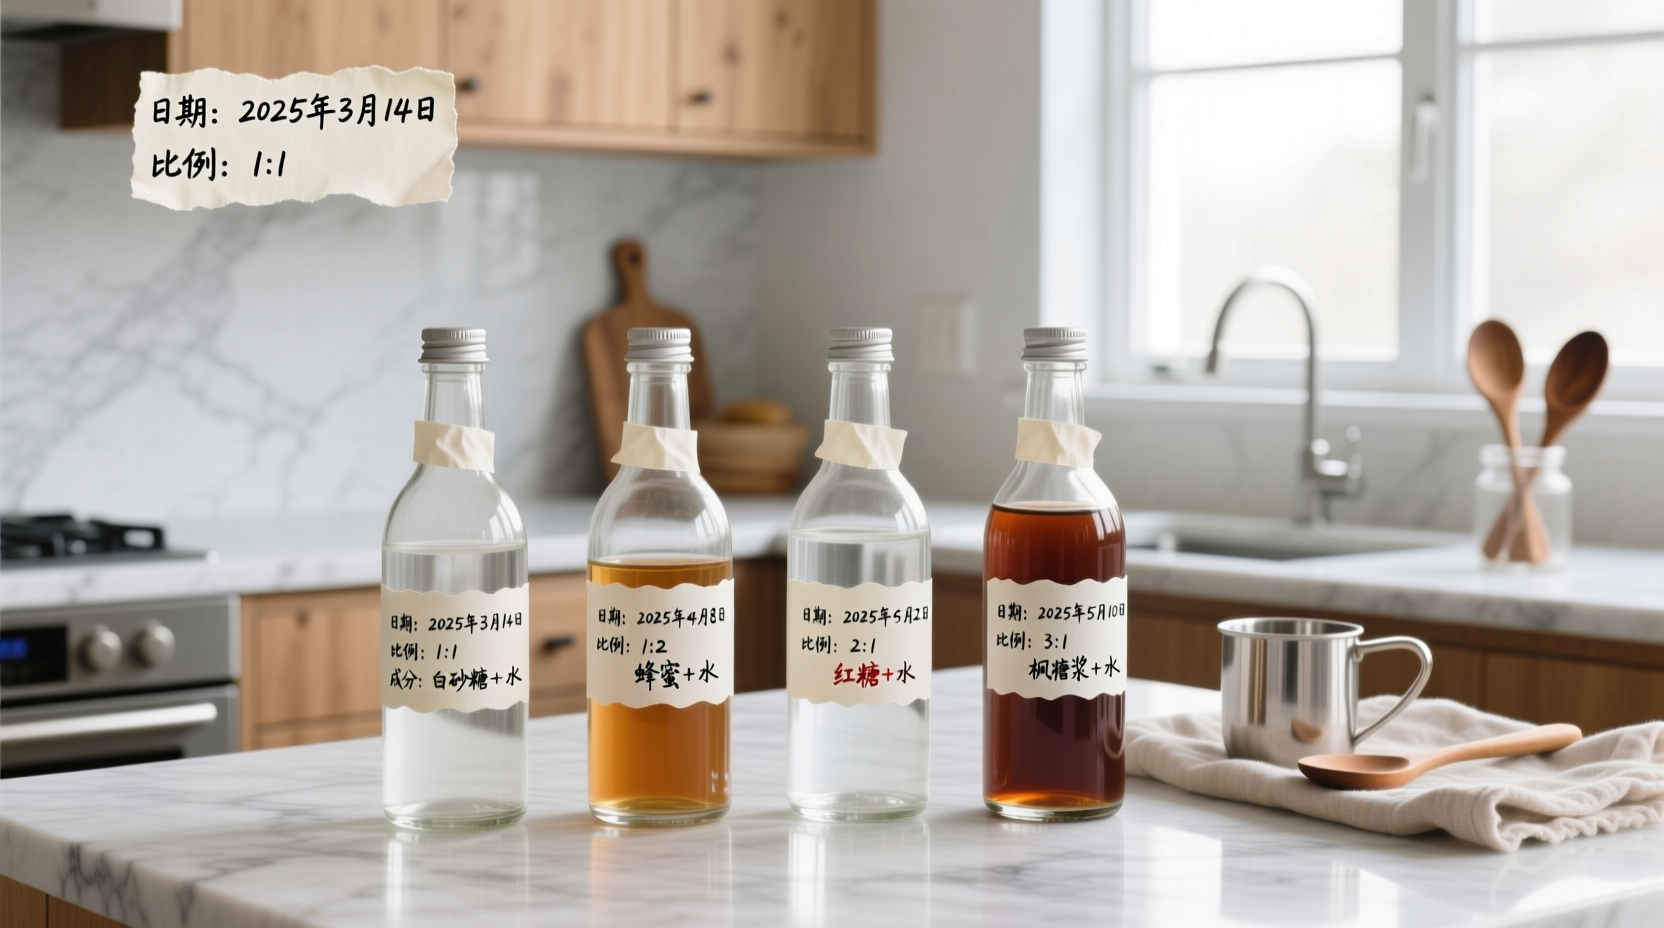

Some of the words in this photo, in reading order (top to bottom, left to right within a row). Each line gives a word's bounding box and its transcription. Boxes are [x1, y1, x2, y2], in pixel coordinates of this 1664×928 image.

[634, 659, 719, 692] 蜂蜜+水
[833, 660, 916, 689] 红糖+水
